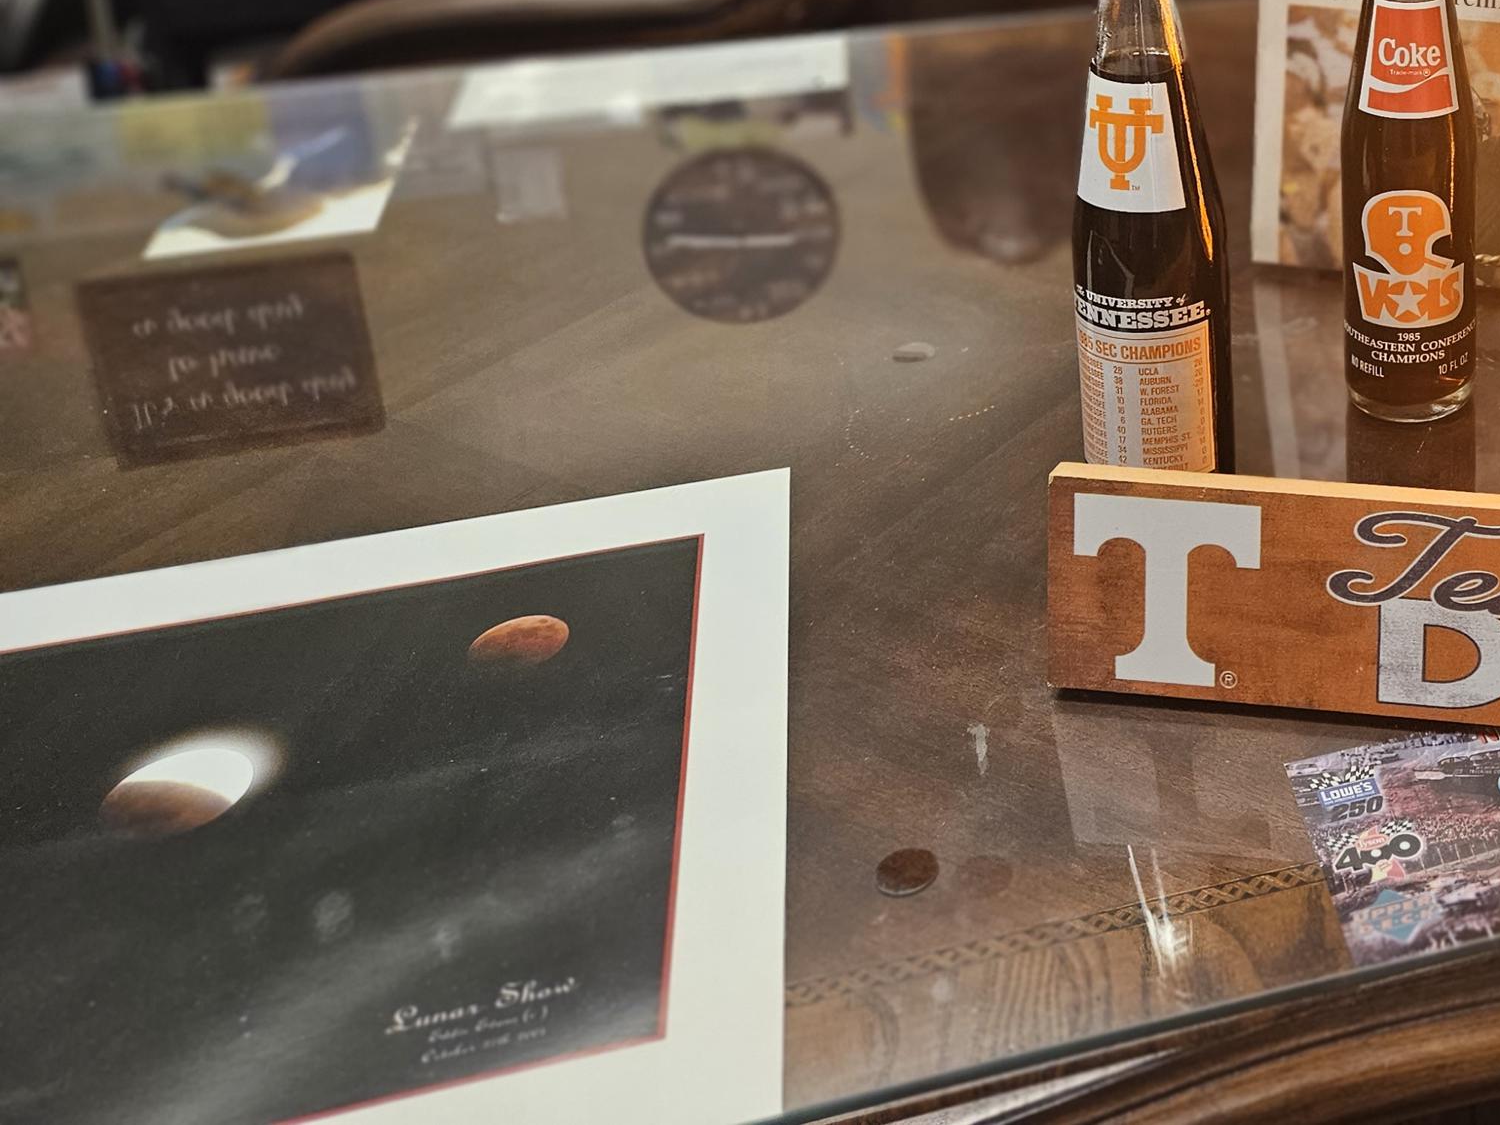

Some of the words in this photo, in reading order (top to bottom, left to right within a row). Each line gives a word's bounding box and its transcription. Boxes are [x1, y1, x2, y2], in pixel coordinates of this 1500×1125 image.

[1378, 37, 1441, 67] Coke
[1388, 206, 1422, 237] T
[1086, 289, 1173, 309] UNIVERSITY
[1358, 271, 1461, 324] VOLS
[1397, 332, 1421, 342] 1985
[1096, 339, 1117, 358] SEC
[1120, 337, 1201, 361] CHAMPIONS
[1371, 350, 1445, 364] CHAMPIONS
[1351, 354, 1359, 367] NO
[1360, 359, 1384, 378] REFILL
[1438, 363, 1448, 375] 10
[1449, 360, 1458, 372] FL
[1459, 352, 1469, 366] OZ
[1138, 367, 1159, 376] UCLA
[1139, 376, 1172, 386] AUBURN
[1139, 387, 1149, 396] W.
[1151, 385, 1180, 395] FOREST
[1140, 396, 1173, 406] FLORIDA
[1141, 406, 1179, 416] ALABAMA
[1141, 417, 1154, 426] GA.
[1156, 416, 1178, 425] TECH
[1141, 425, 1178, 436] RUTGERS
[1142, 435, 1179, 445] MEMPHIS
[1142, 444, 1189, 455] MISSISSIPPI
[1143, 455, 1185, 465] KENTUCKY
[1073, 491, 1262, 688] T
[1320, 780, 1373, 803] LOWE'S
[1332, 795, 1384, 822] 250
[385, 1005, 480, 1035] Lunar
[494, 976, 577, 1008] Show
